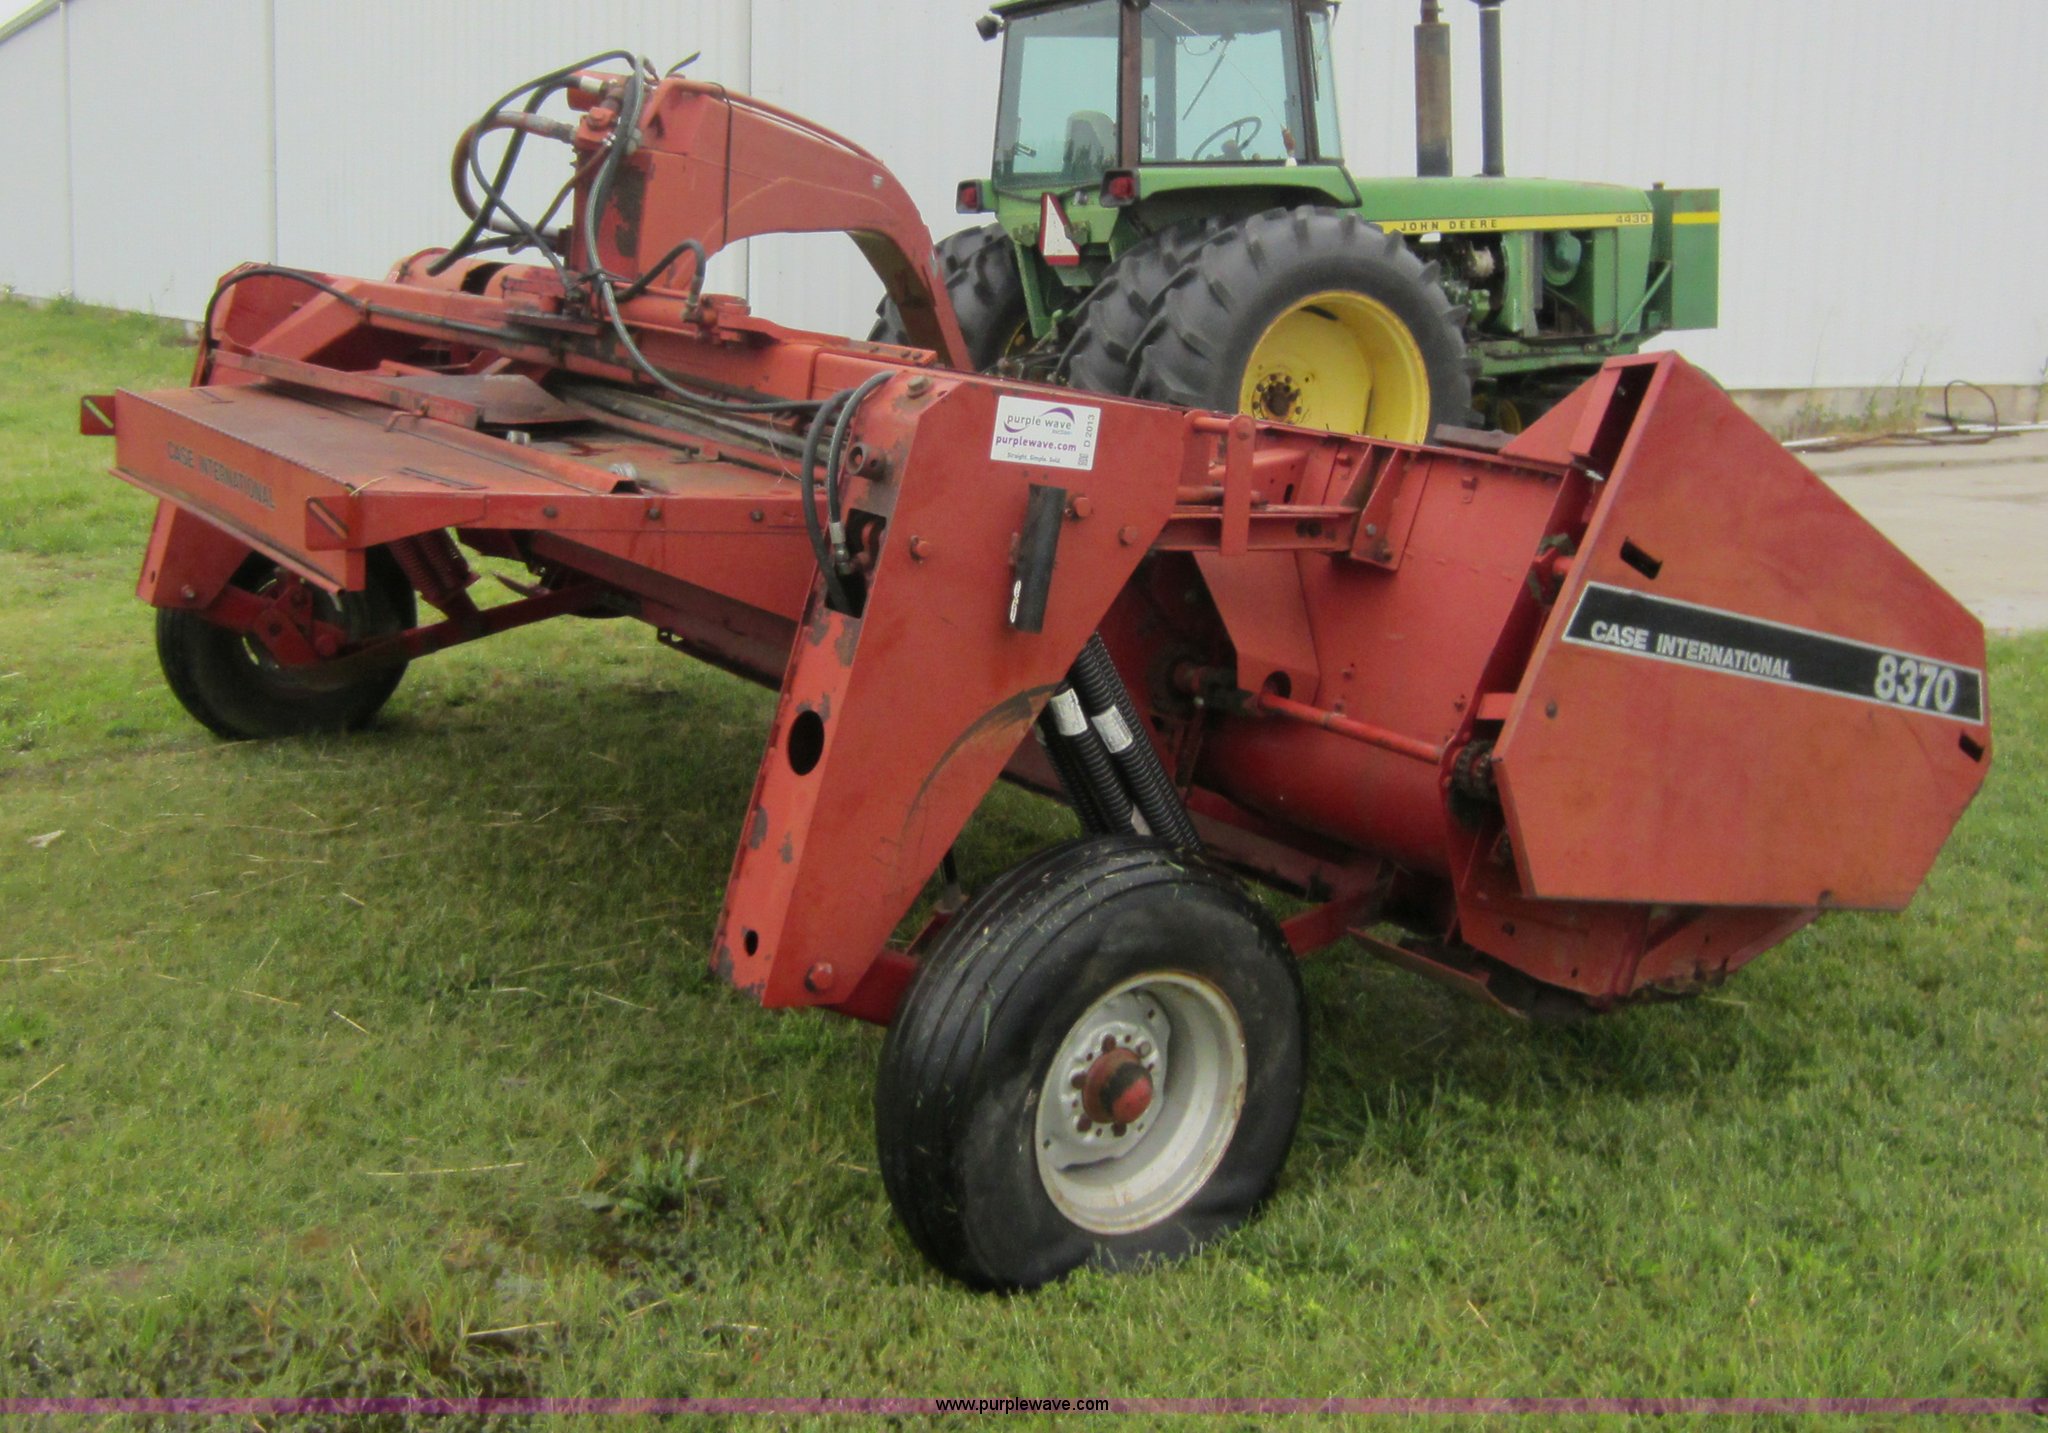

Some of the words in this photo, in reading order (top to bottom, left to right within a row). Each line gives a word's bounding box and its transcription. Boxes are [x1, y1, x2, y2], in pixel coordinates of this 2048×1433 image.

[1401, 222, 1439, 231] JOHN
[1449, 219, 1497, 229] DEERE
[1616, 214, 1649, 224] 4430
[1007, 415, 1041, 425] purple
[1045, 419, 1072, 430] wave
[1086, 414, 1096, 438] 2013
[996, 436, 1077, 452] purplewave.com
[167, 441, 194, 469] CASE
[200, 456, 276, 511] INTERNATIONAL
[1591, 620, 1649, 650] CASE
[1656, 633, 1791, 680] INTERNATIONAL
[1874, 654, 1957, 713] 8370
